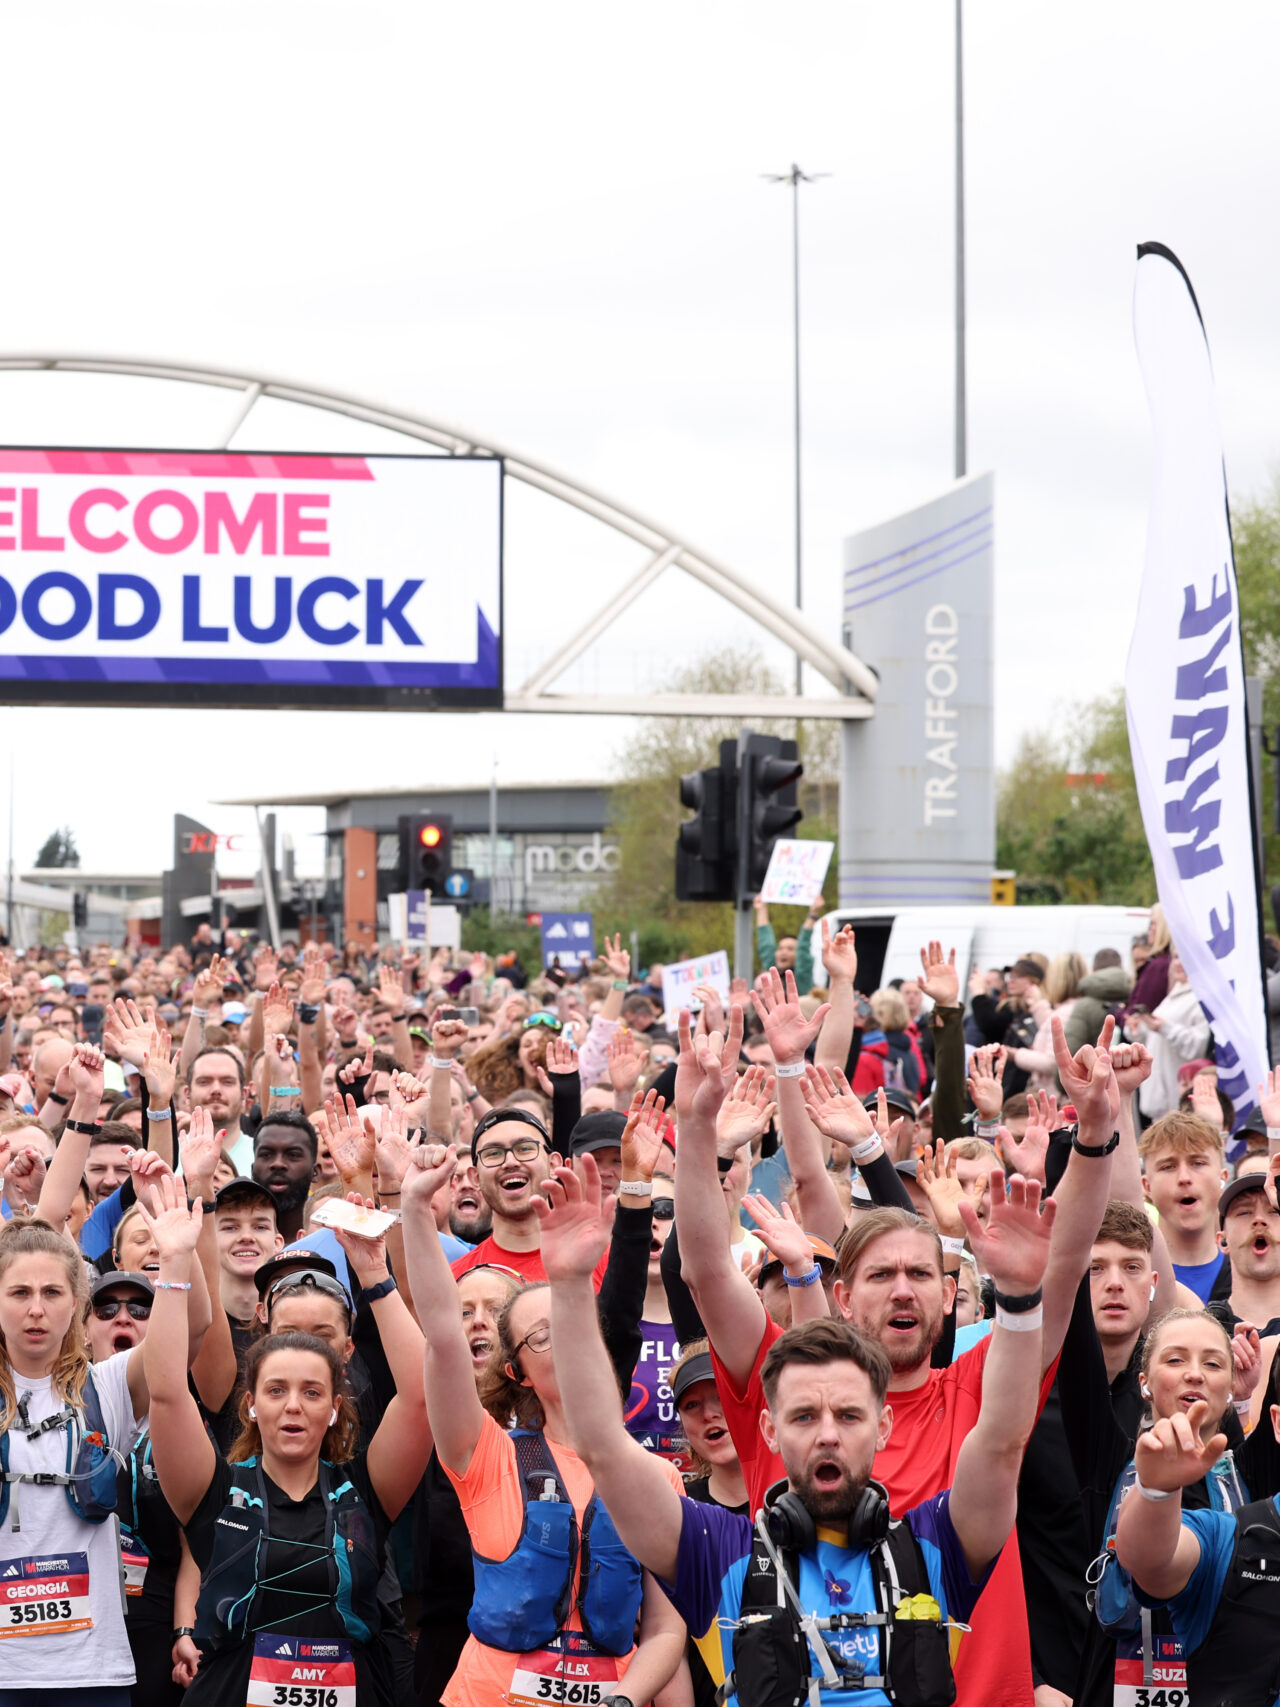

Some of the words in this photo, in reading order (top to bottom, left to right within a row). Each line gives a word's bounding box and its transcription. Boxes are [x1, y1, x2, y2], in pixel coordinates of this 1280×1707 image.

[182, 574, 426, 646] LUCK
[924, 603, 959, 827] TRAFFORD
[188, 831, 244, 852] KFC
[216, 1518, 249, 1531] SALOMON
[36, 1563, 70, 1573] MARATHON
[6, 1581, 70, 1599] GEORGIA
[9, 1600, 72, 1624] 35183
[311, 1649, 340, 1657] MARATHON
[291, 1667, 327, 1681] AMY
[554, 1660, 591, 1676] ALEX
[273, 1685, 338, 1707] 35316
[536, 1677, 601, 1704] 33615
